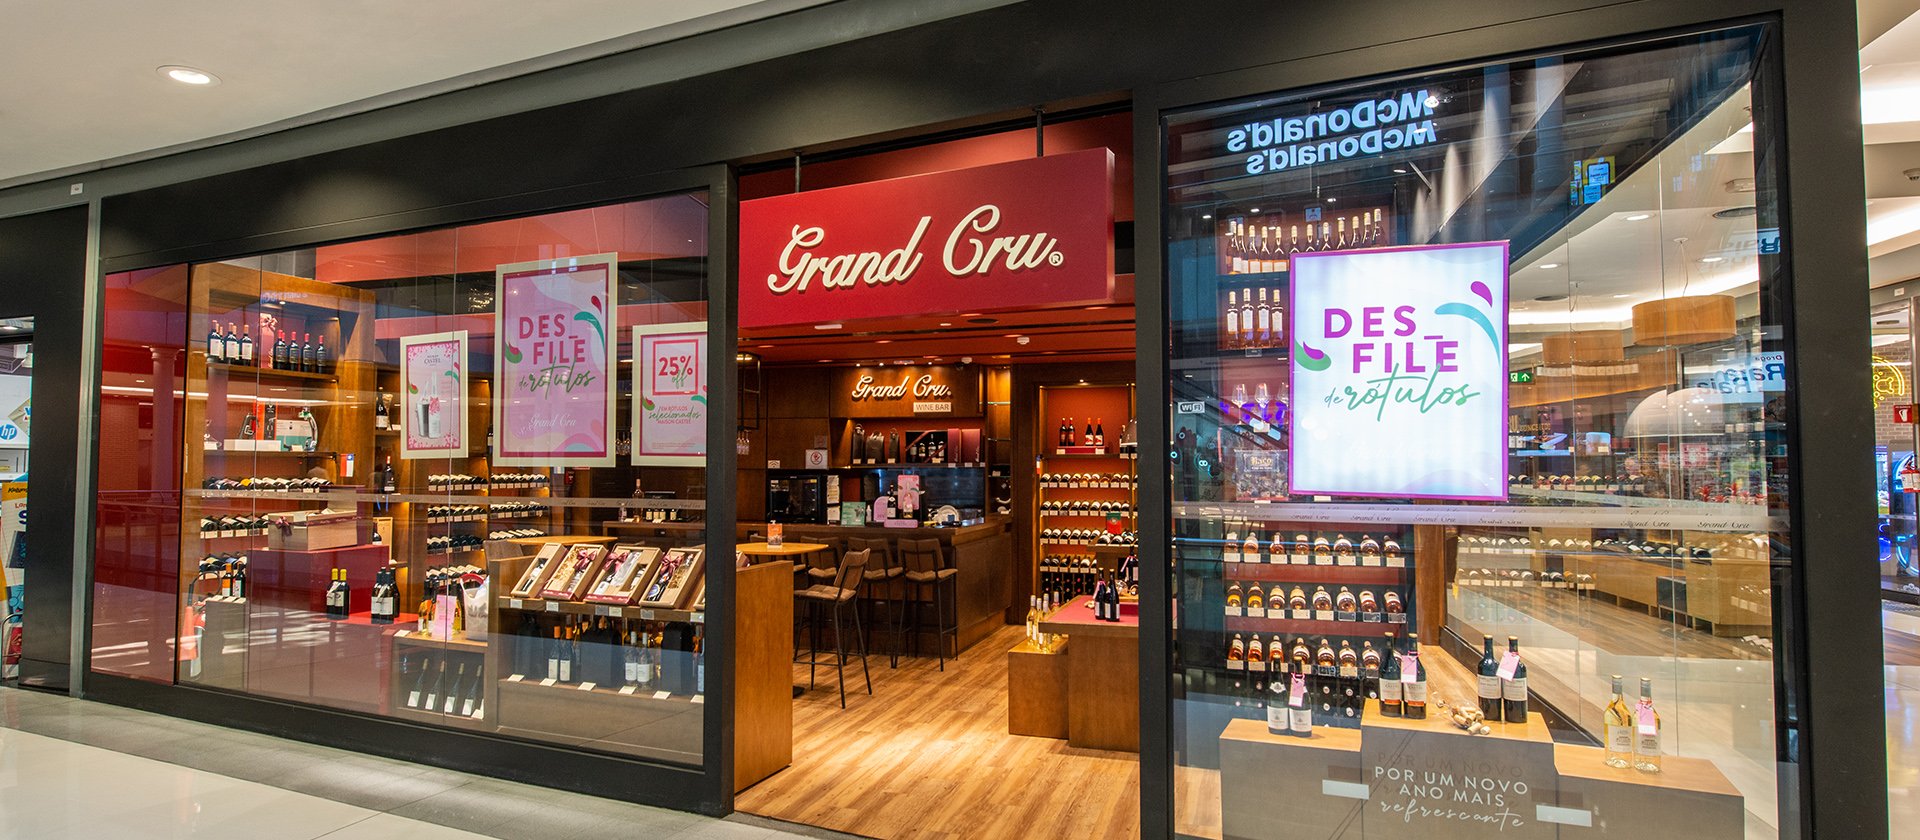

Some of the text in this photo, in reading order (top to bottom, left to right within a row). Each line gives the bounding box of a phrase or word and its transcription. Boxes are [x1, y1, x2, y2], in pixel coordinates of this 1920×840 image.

[767, 215, 932, 294] Grand
[533, 339, 586, 365] FILE
[1353, 340, 1458, 373] FILE
[659, 356, 693, 377] 25%
[851, 374, 910, 398] Grand
[1324, 362, 1480, 422] de rótulos
[649, 405, 701, 421] selecionados
[1, 424, 15, 440] hp
[1375, 766, 1528, 795] POR UM NOVO
[1399, 784, 1505, 807] ANO MAIS
[1380, 798, 1524, 832] refrescante
